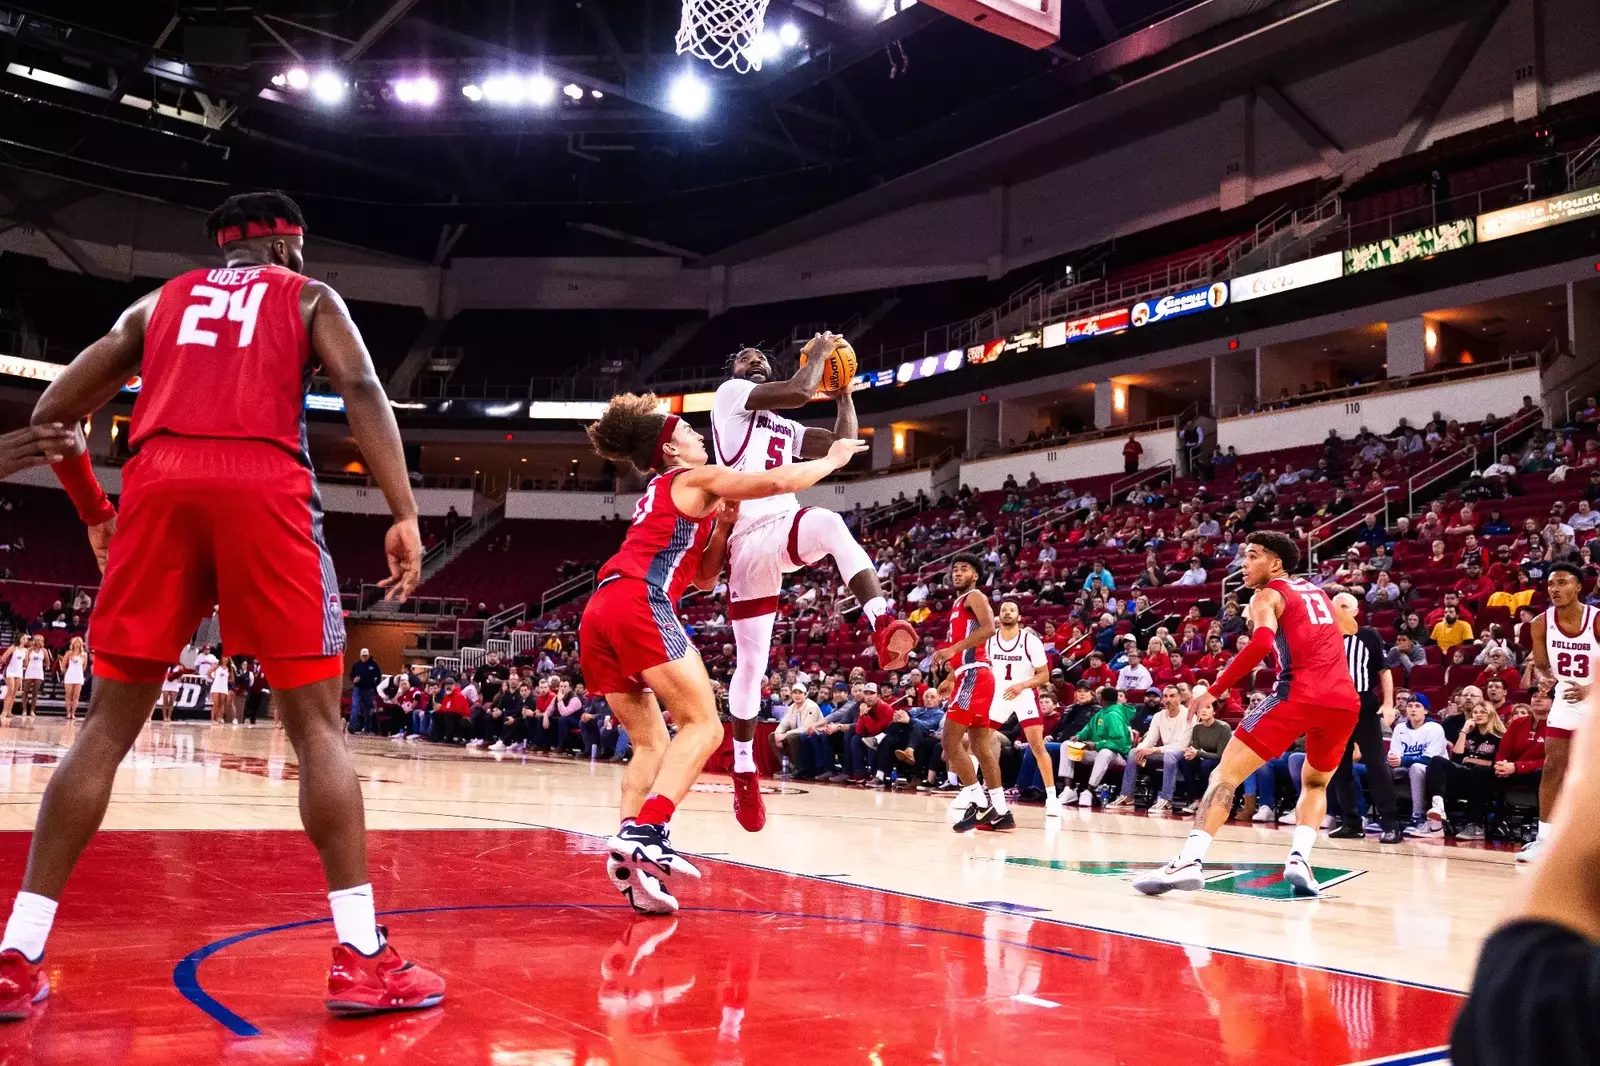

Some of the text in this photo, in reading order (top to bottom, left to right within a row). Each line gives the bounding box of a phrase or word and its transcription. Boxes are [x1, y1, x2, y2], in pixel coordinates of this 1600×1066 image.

[176, 282, 269, 348] 24
[829, 356, 840, 389] Wilson
[1345, 402, 1361, 415] 110
[765, 435, 786, 471] 5
[1048, 451, 1057, 462] 111
[1301, 593, 1334, 625] 13
[1552, 640, 1591, 652] BULLDOGS
[993, 654, 1022, 662] BULLDOGS
[1557, 652, 1590, 678] 23
[1005, 663, 1012, 680] 1
